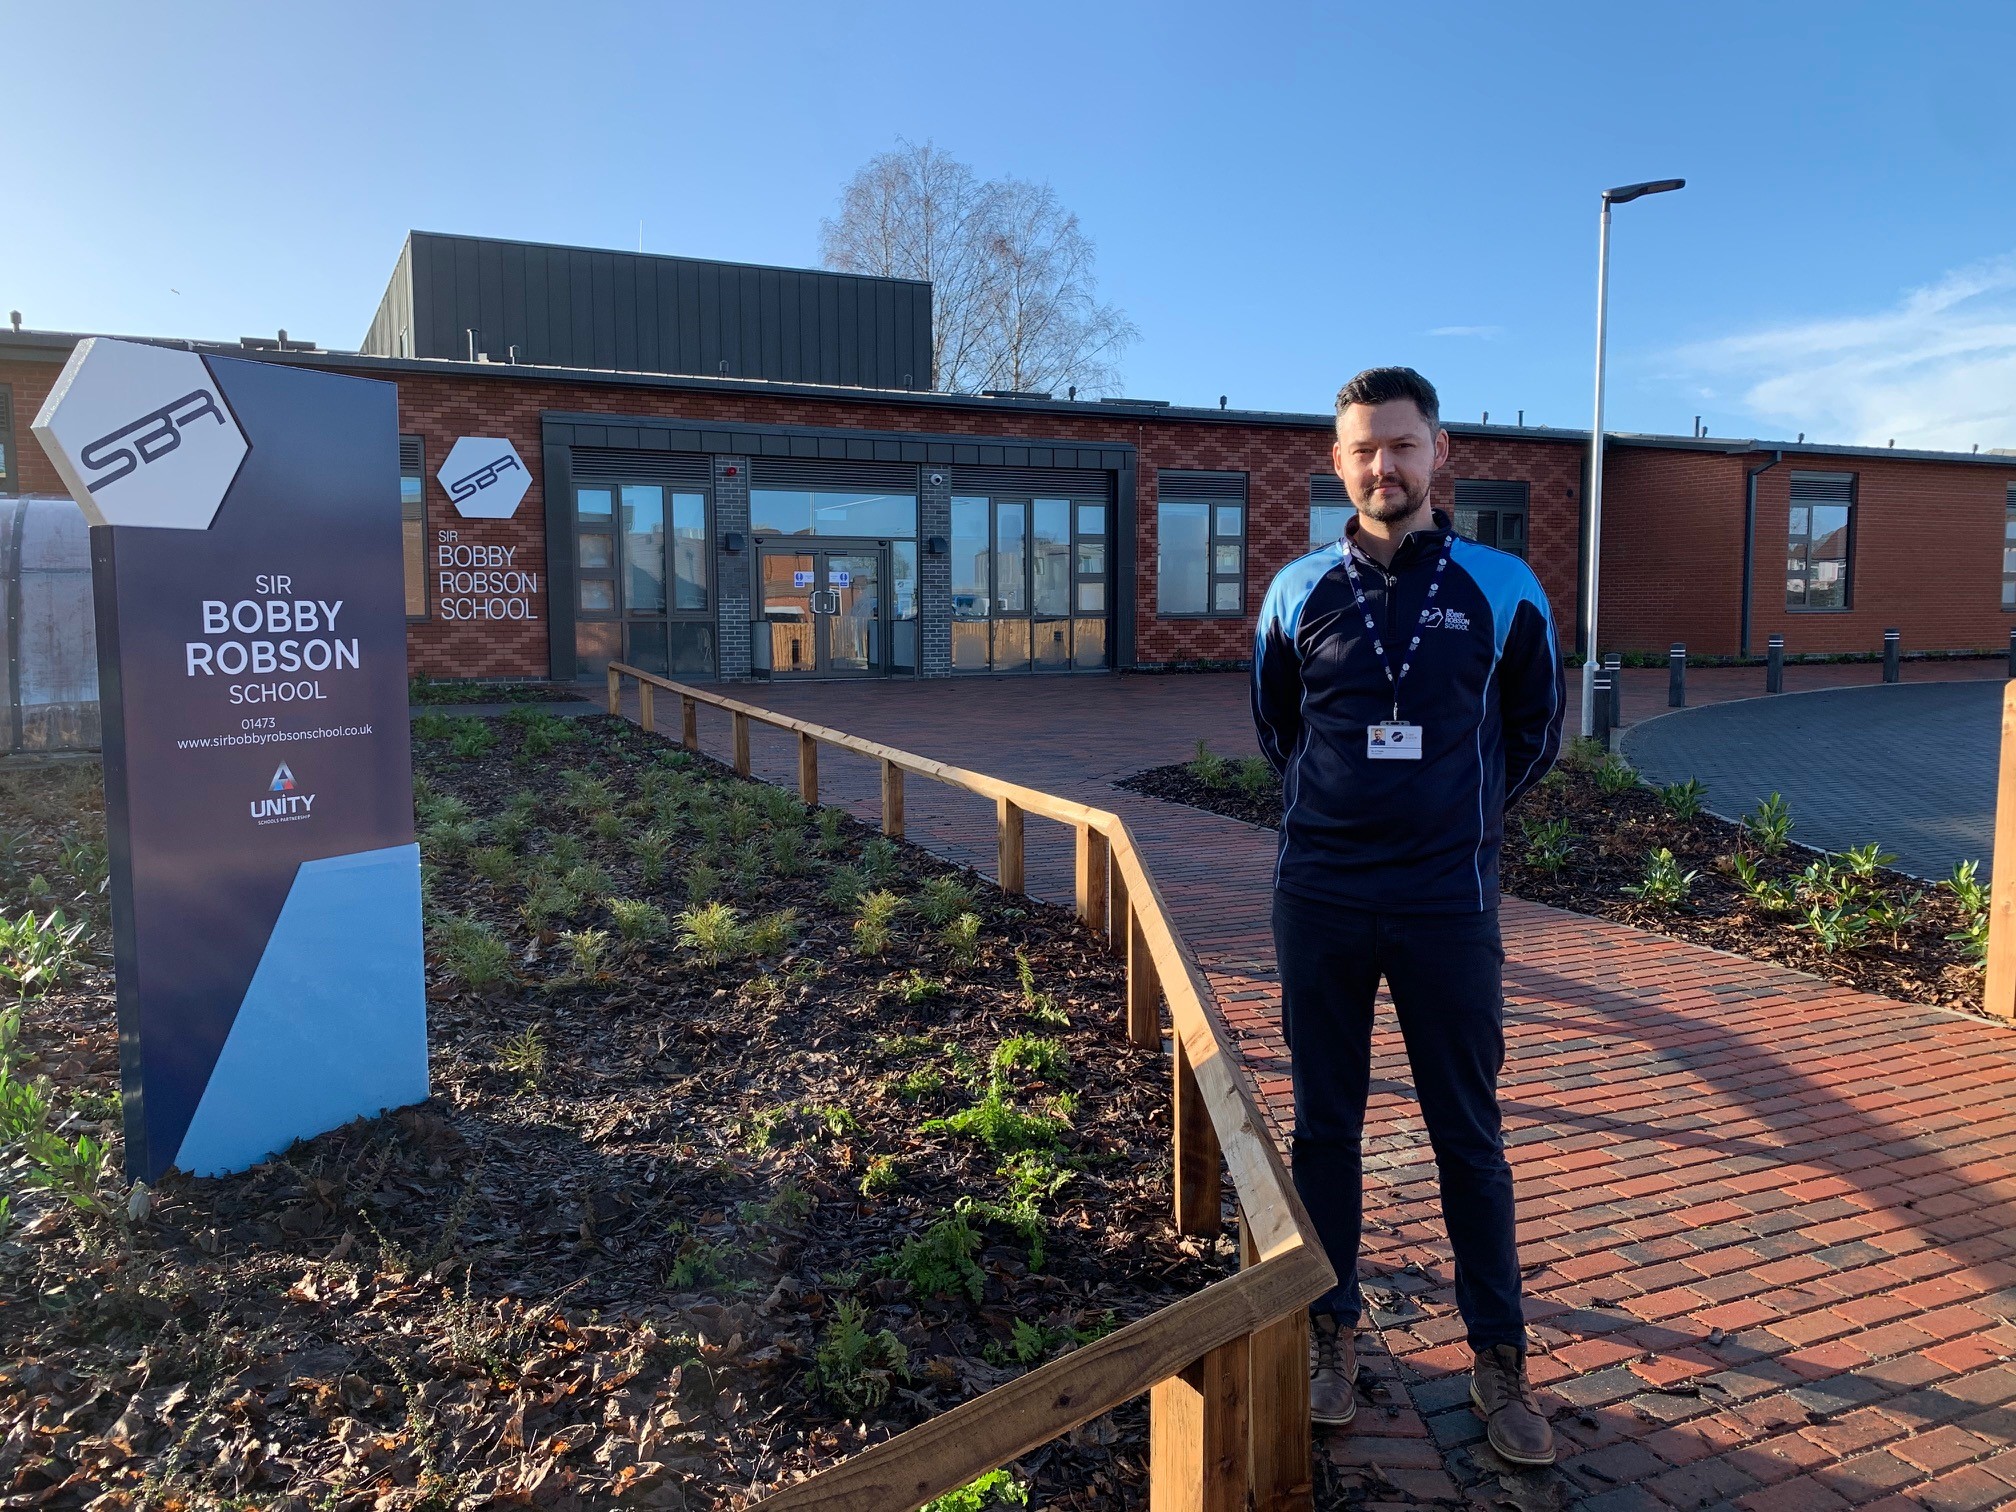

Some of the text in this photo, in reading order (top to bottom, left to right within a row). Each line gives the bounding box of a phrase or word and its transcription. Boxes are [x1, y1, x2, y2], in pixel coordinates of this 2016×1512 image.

[81, 388, 226, 494] SBR
[451, 454, 520, 504] SBR
[438, 530, 458, 542] SIR
[438, 545, 516, 567] BOBBY
[255, 574, 292, 594] SIR
[440, 571, 537, 593] ROBSON
[202, 599, 343, 634] BOBBY
[441, 597, 538, 620] SCHOOL
[186, 638, 360, 677] ROBSON
[229, 681, 327, 706] SCHOOL
[241, 717, 276, 730] 01473
[177, 724, 373, 750] www.sirbobbyrobsonschool.co.uk
